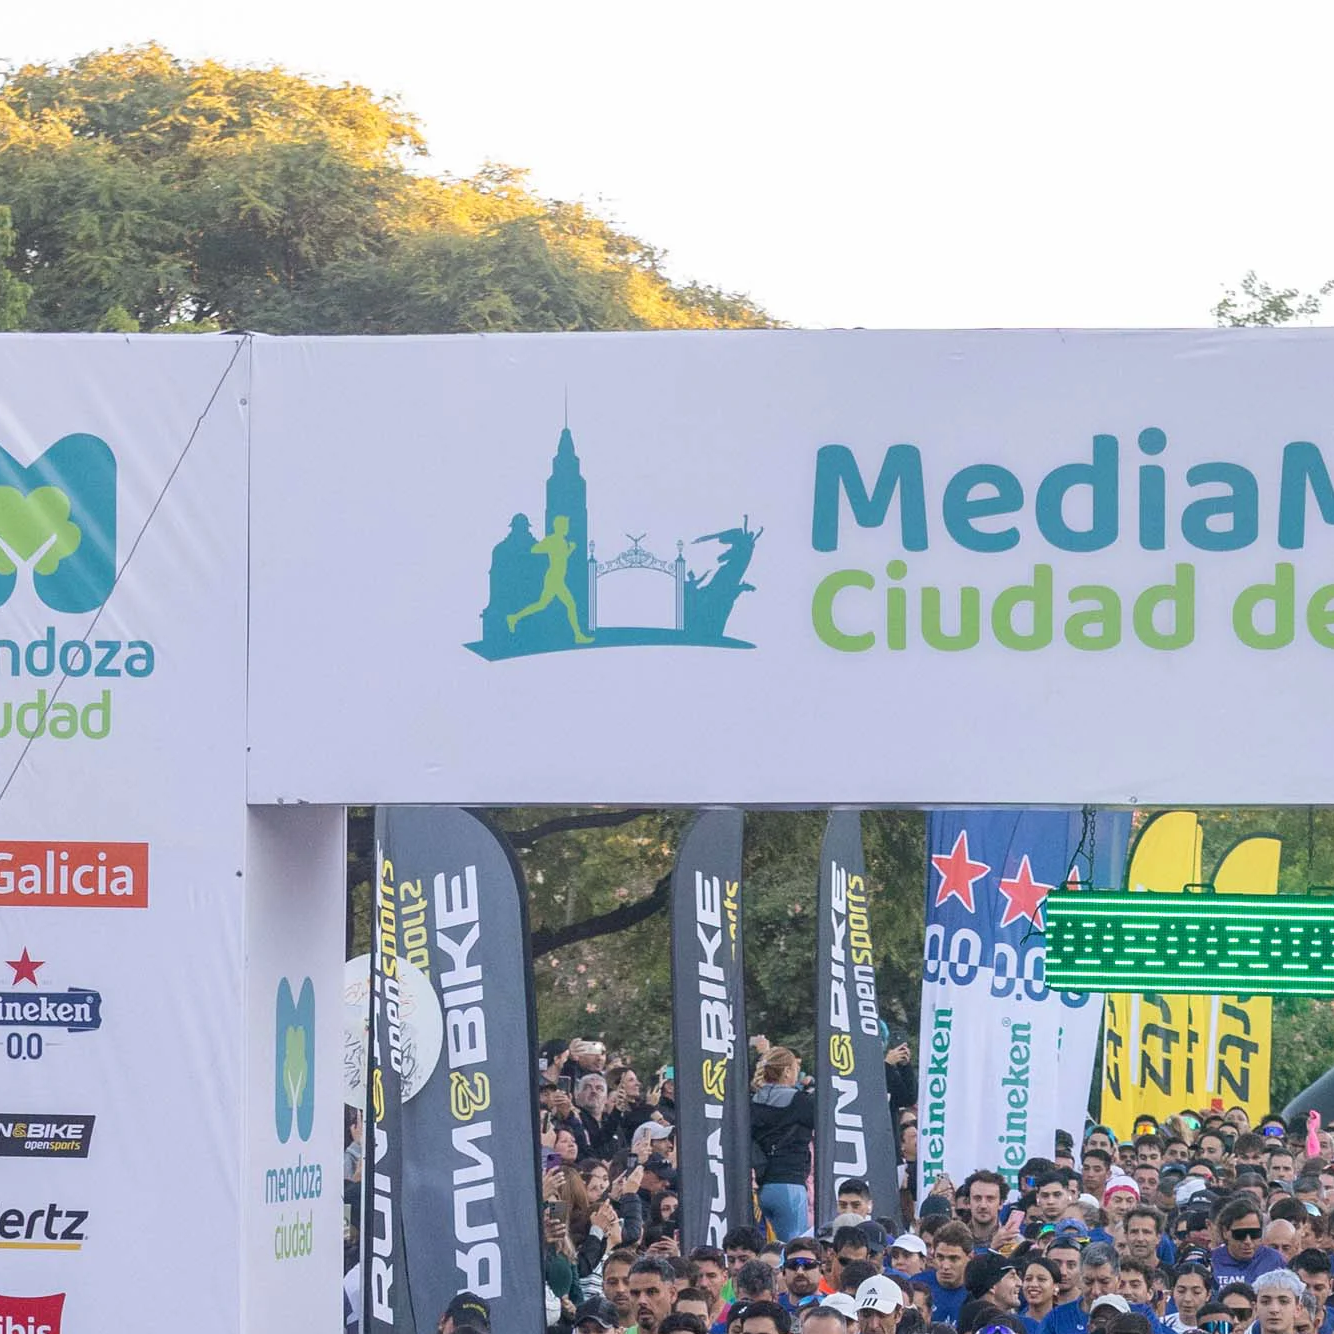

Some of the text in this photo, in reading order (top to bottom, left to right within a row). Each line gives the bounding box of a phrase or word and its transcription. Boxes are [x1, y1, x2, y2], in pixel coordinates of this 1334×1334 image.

[812, 560, 1195, 652] Ciudad
[846, 872, 879, 1036] opensports
[6, 1032, 43, 1060] 0.0
[24, 1139, 82, 1151] opensports
[266, 1154, 322, 1205] mendoza
[275, 1209, 313, 1260] ciudad
